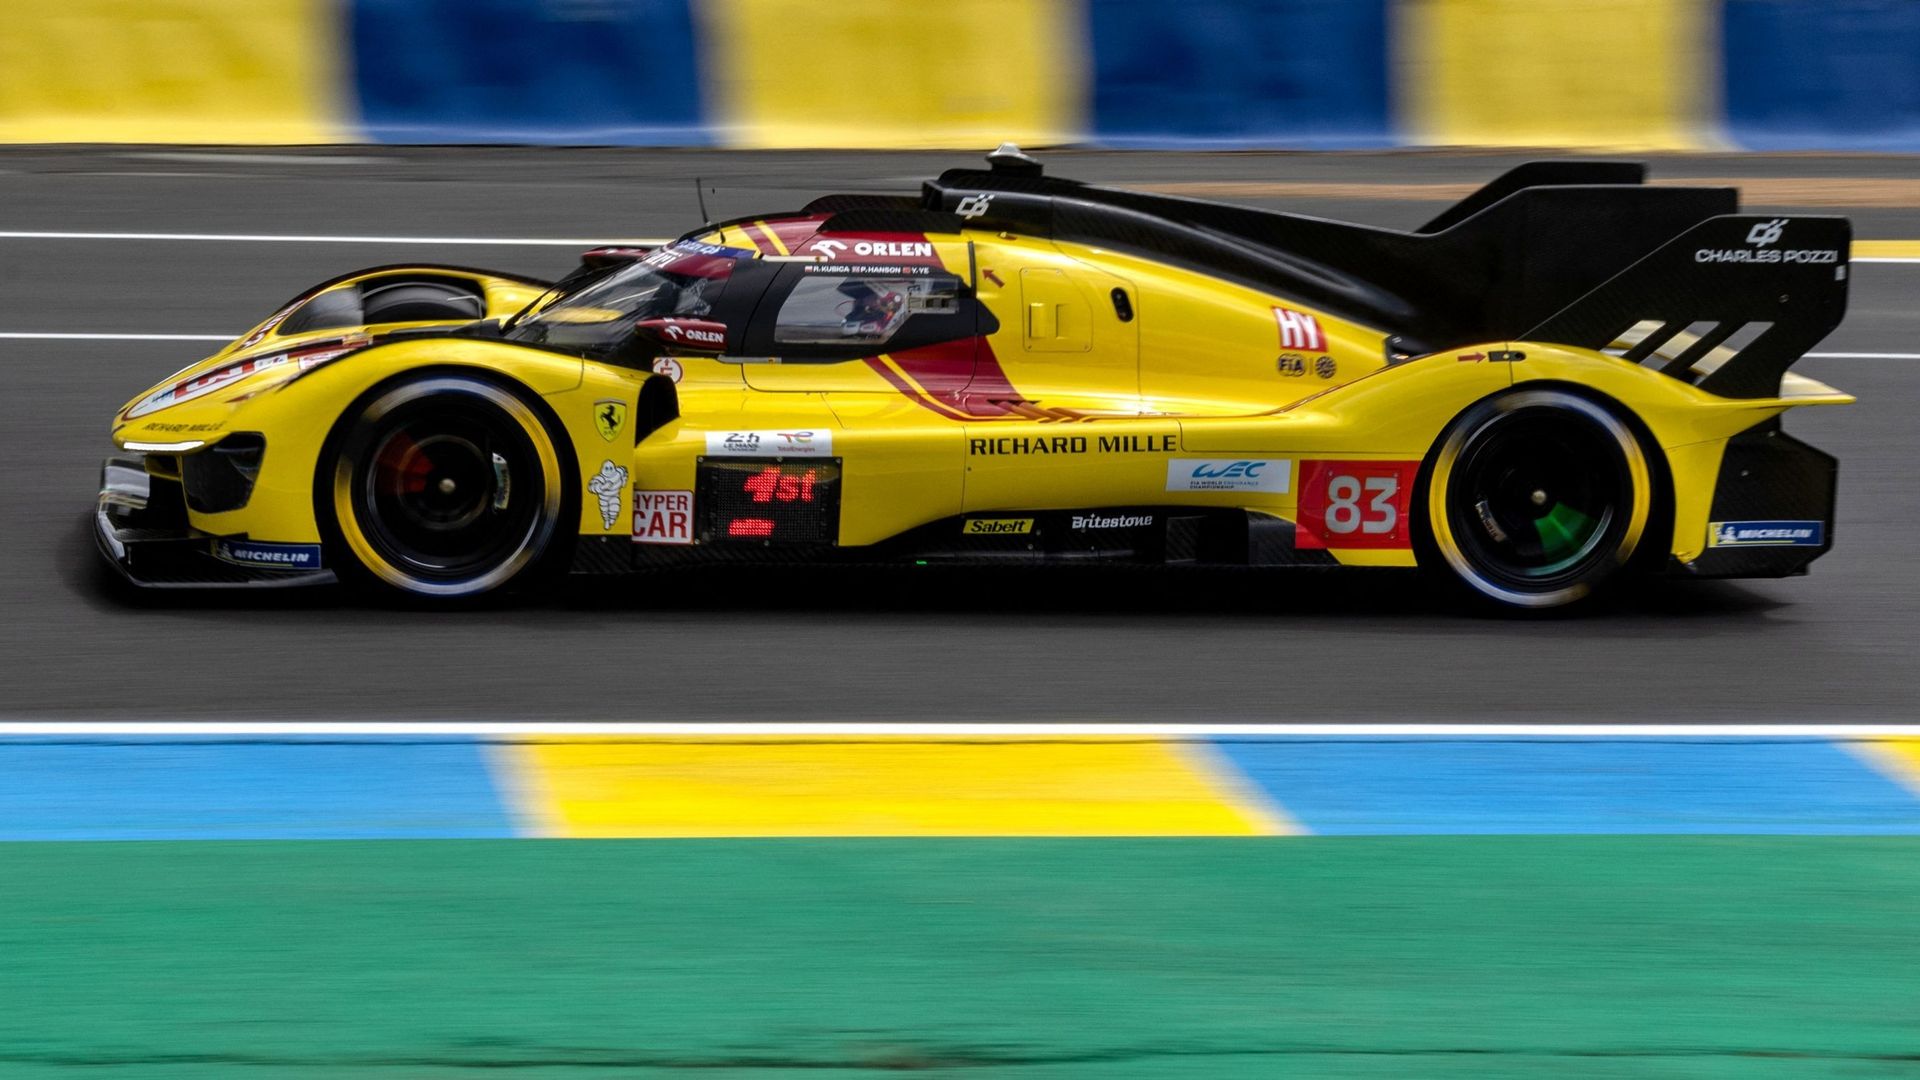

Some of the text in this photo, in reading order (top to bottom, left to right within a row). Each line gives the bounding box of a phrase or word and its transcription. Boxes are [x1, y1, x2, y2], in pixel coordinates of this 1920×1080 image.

[854, 242, 932, 257] ORLEN
[1694, 249, 1838, 263] CHARLES POZZI
[685, 329, 724, 343] ORLEN
[1274, 307, 1320, 350] HY
[970, 434, 1177, 455] RICHARD MILLE
[1192, 461, 1266, 478] WEC
[633, 494, 688, 511] HYPER
[1324, 474, 1398, 535] 83
[632, 511, 688, 538] CAR
[970, 519, 1026, 533] Sabelt
[1072, 512, 1153, 530] Britestone
[1737, 528, 1813, 539] MICHELIN
[234, 549, 310, 562] MICHELIN
